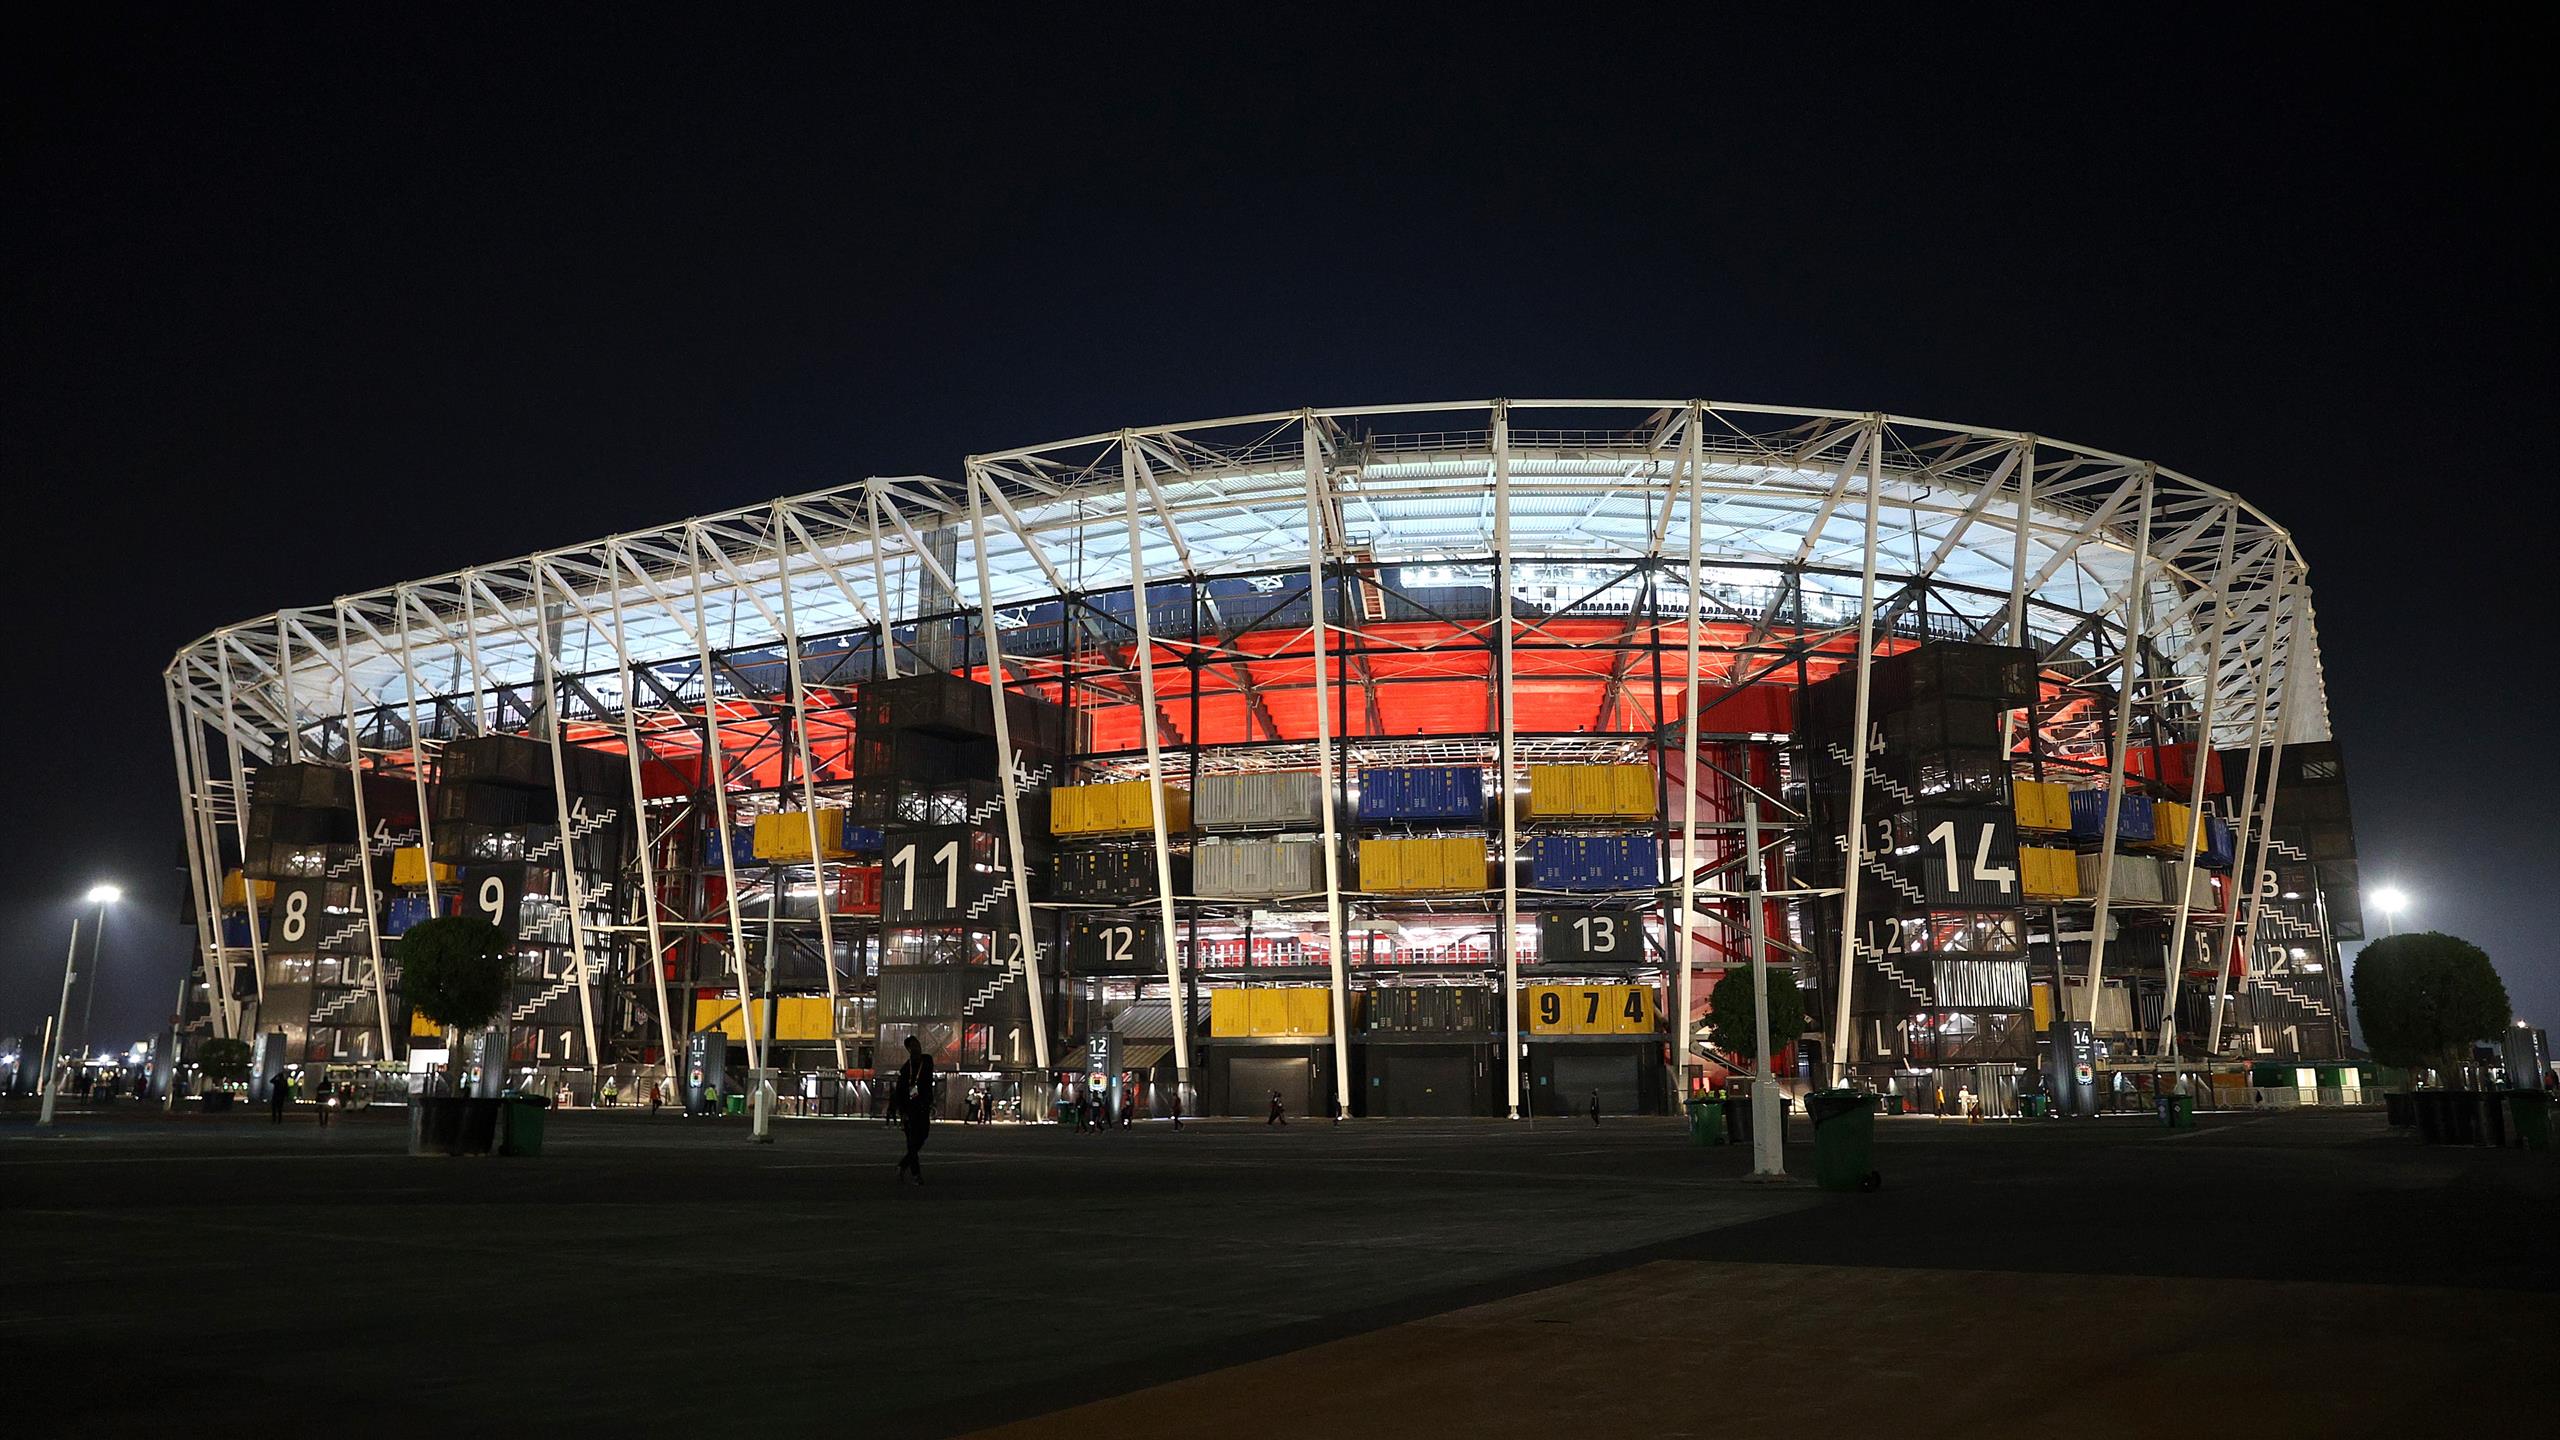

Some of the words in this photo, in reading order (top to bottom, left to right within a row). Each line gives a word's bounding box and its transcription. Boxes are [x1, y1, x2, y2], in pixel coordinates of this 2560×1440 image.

[1861, 819, 1894, 860] L3
[1927, 821, 2015, 893] 14
[891, 841, 958, 911] 11
[283, 891, 307, 942] 8
[479, 876, 504, 926] 9
[991, 931, 1022, 968] L2
[1099, 927, 1133, 961] 12
[1573, 917, 1616, 952] 13
[1868, 918, 1901, 957] L2
[2195, 932, 2210, 963] 15
[342, 957, 376, 985] L2
[543, 949, 577, 982] L2
[333, 1030, 369, 1057] L1
[537, 1029, 571, 1059] L1
[692, 1038, 705, 1051] 11
[988, 1026, 1020, 1062] L1
[1089, 1039, 1107, 1053] 12
[1876, 1019, 1909, 1056] L1
[2073, 1030, 2090, 1045] 14
[2253, 1025, 2299, 1054] L1
